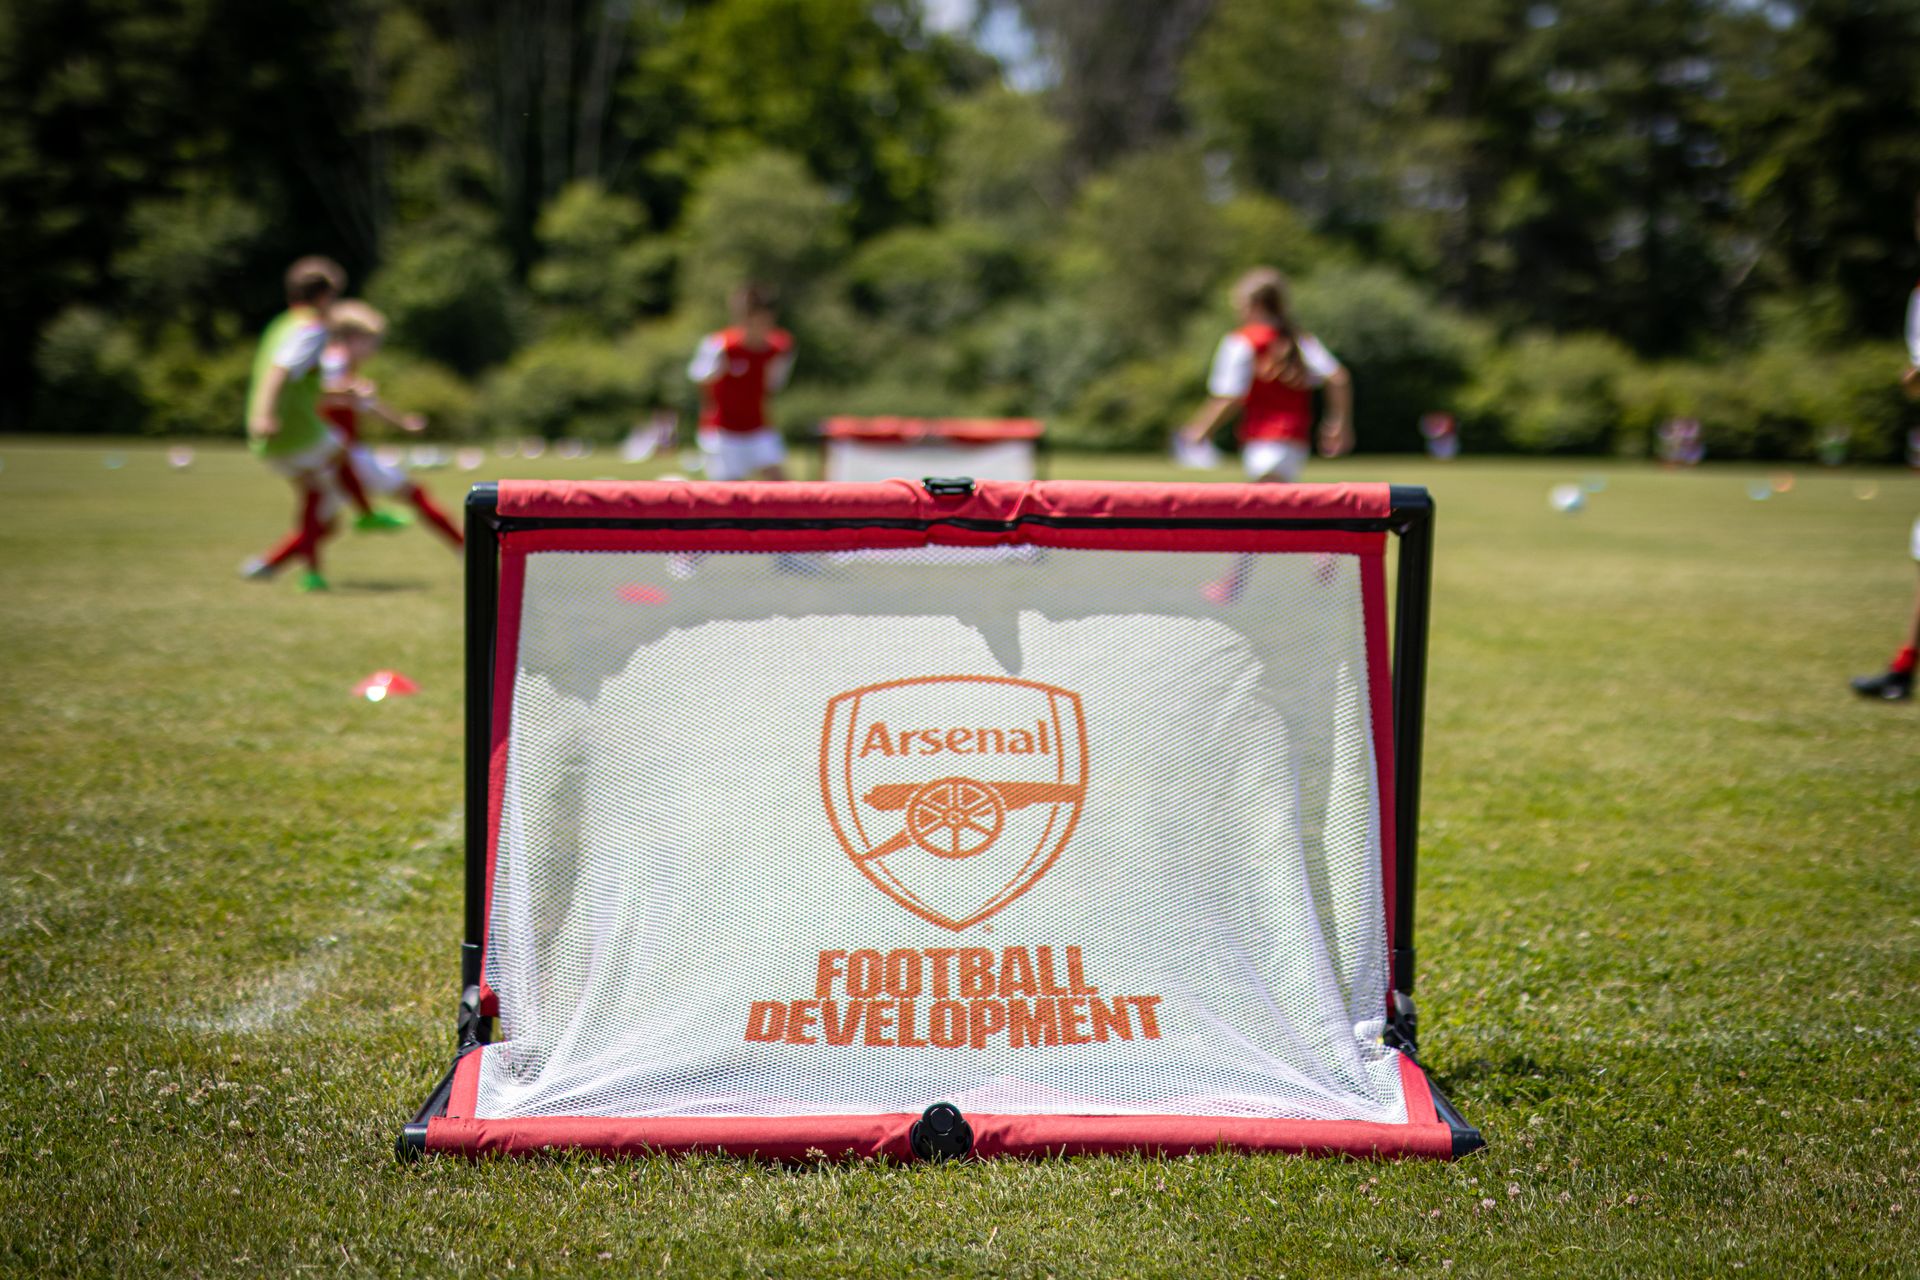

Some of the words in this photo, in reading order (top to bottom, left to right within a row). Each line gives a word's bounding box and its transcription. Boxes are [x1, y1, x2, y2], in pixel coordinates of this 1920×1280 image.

[858, 719, 1050, 758] Arsenal
[814, 945, 1099, 999] FOOTBALL
[744, 994, 1163, 1050] DEVELOPMENT
